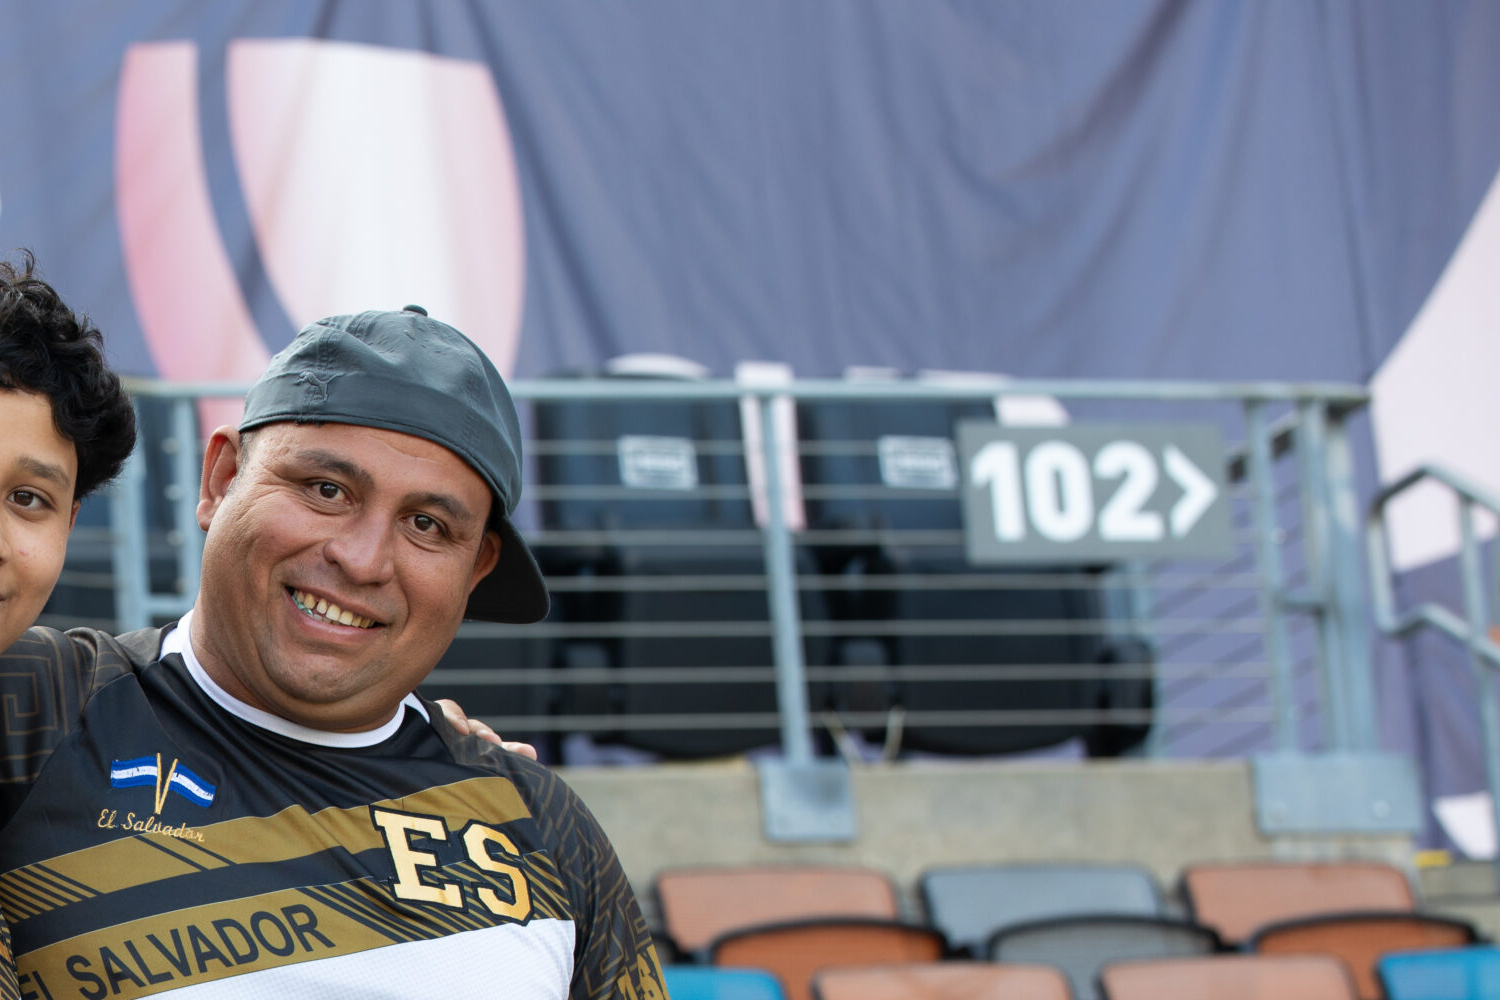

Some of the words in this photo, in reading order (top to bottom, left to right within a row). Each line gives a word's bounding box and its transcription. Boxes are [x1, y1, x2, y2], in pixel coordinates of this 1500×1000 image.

[971, 441, 1164, 542] 102
[97, 808, 117, 829] El
[369, 804, 534, 927] ES
